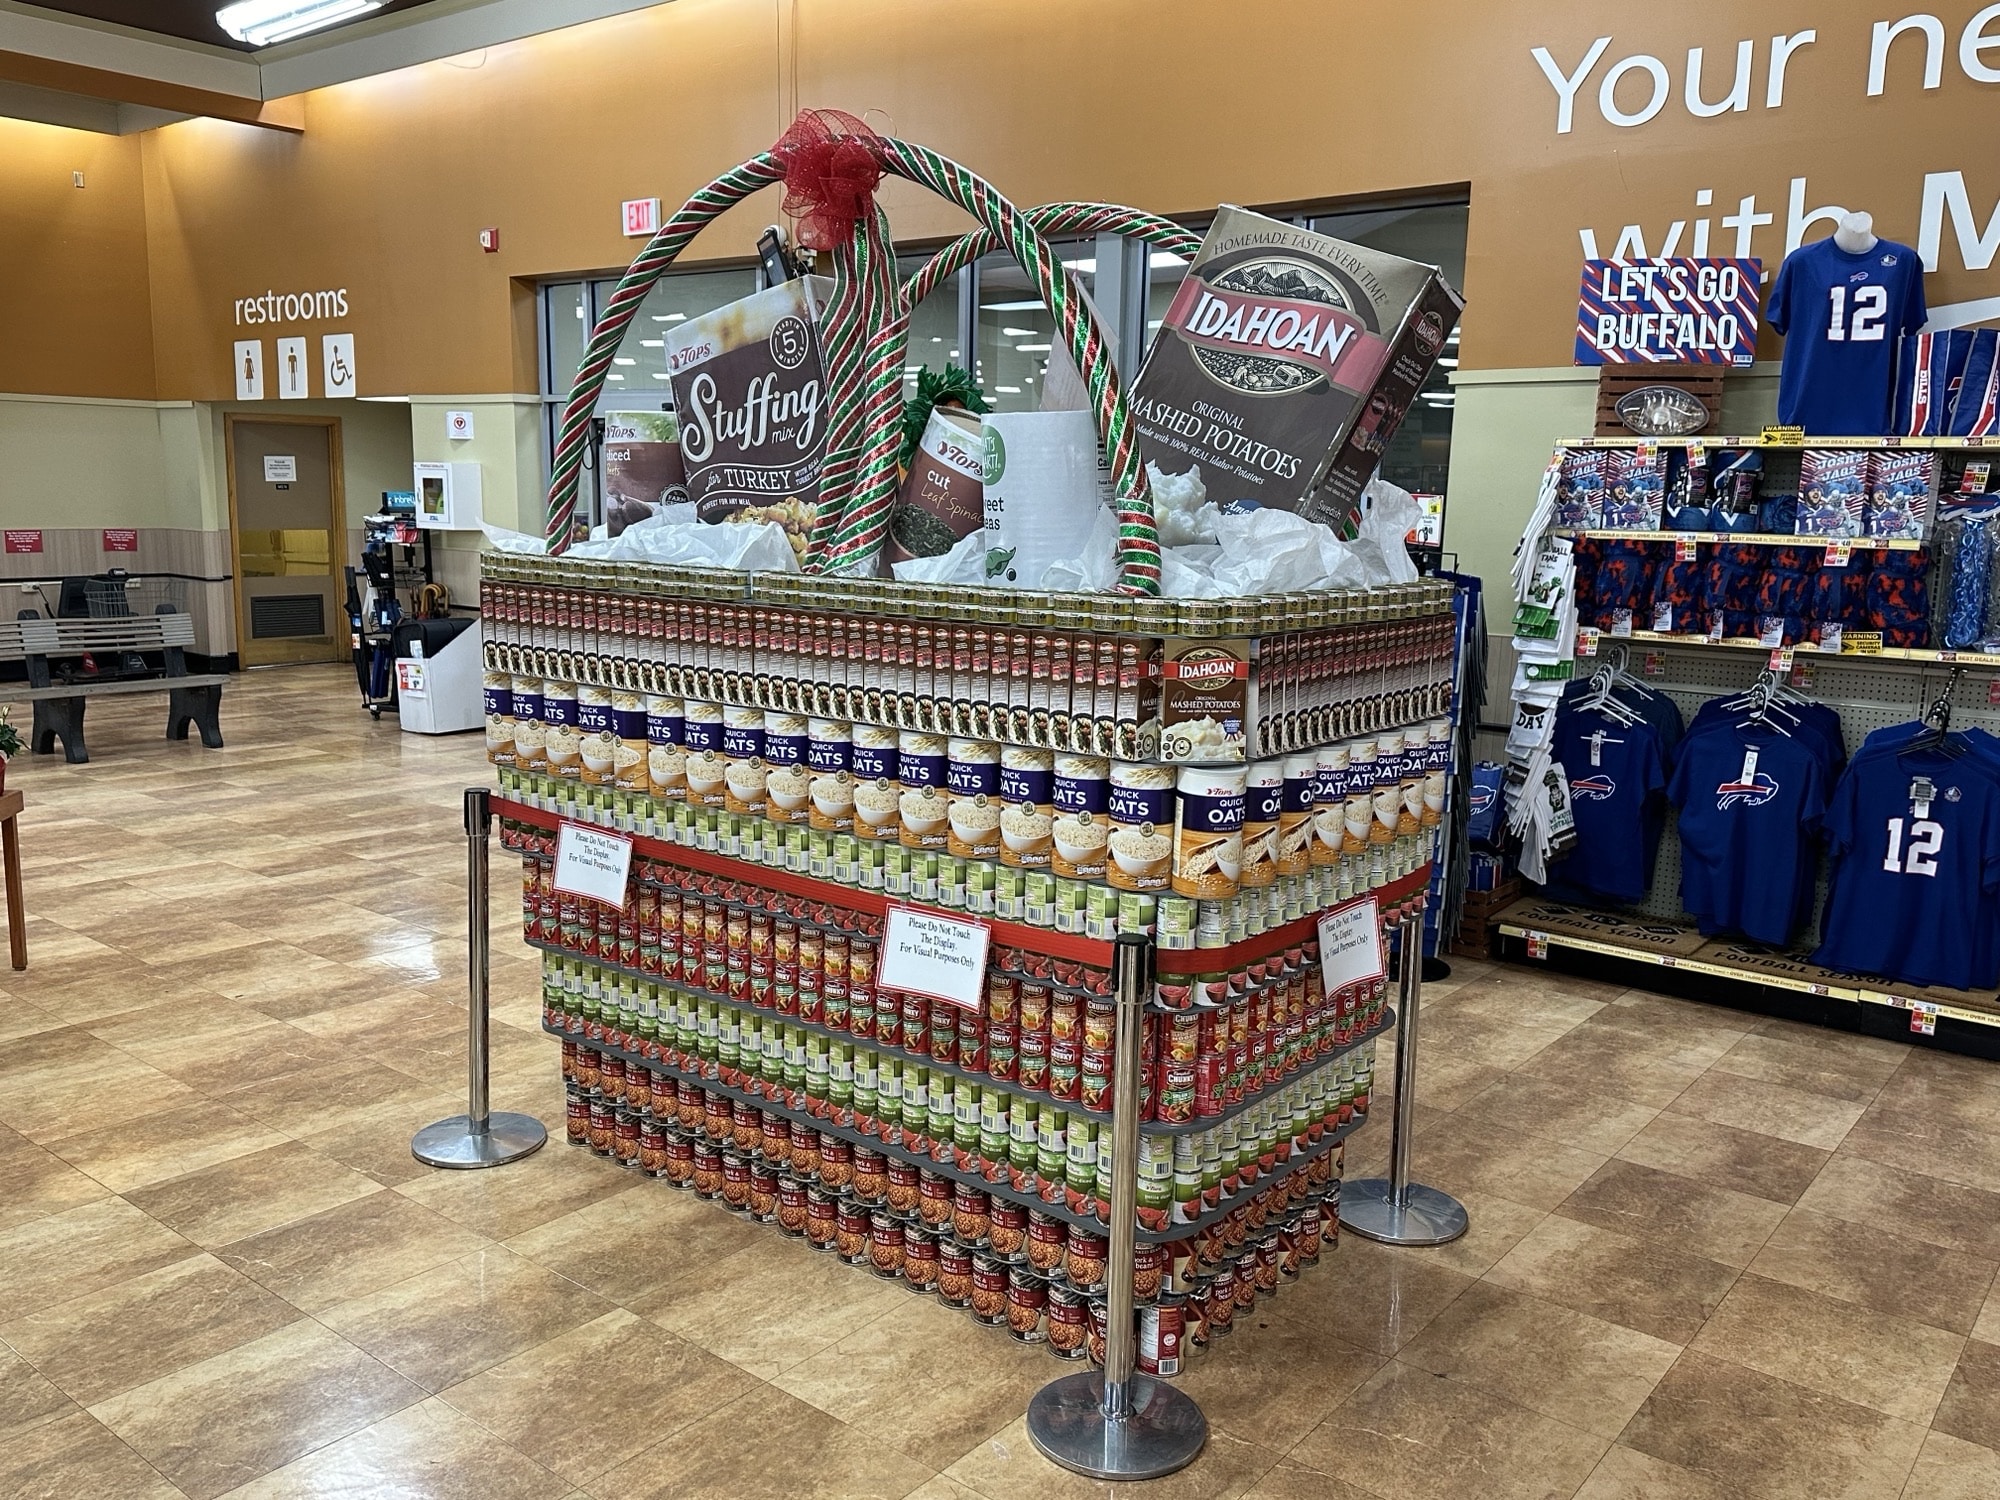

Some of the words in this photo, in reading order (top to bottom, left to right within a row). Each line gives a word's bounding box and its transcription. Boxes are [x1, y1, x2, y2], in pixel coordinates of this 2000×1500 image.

[1530, 30, 1816, 134] Your
[628, 202, 650, 231] EXIT
[1214, 232, 1289, 256] HOMEMADE
[1291, 233, 1327, 255] TASTE
[1327, 246, 1365, 276] EVERY
[1602, 266, 1688, 303] LET'S
[1697, 266, 1739, 302] GO
[234, 287, 348, 325] restrooms
[1828, 286, 1888, 341] 12
[1185, 291, 1355, 366] IDAHOAN
[1596, 313, 1738, 351] BUFFALO
[782, 330, 797, 354] 5
[1917, 369, 1929, 405] BILLS
[682, 372, 827, 463] Stuffing
[1192, 400, 1245, 431] ORIGINAL
[771, 426, 796, 445] mix
[1126, 392, 1203, 439] MASHED
[1201, 423, 1302, 480] POTATOES
[1135, 423, 1154, 437] Made
[1154, 430, 1170, 444] with
[1169, 438, 1189, 452] 100%
[1189, 446, 1209, 461] REAL
[1233, 465, 1265, 485] Potatoes
[1817, 454, 1863, 469] JOSH'S
[1882, 455, 1928, 469] JOSH'S
[705, 471, 721, 492] for
[724, 469, 791, 490] TURKEY
[927, 468, 951, 491] cut
[719, 498, 728, 506] FOR
[729, 498, 738, 506] ANY
[921, 482, 949, 510] Leaf
[946, 497, 985, 523] Spinac
[984, 497, 1004, 512] eet
[985, 518, 1000, 530] eas
[1179, 661, 1235, 679] IDAHOAN
[1170, 700, 1203, 709] MASHED
[1204, 700, 1241, 709] POTATOES
[1516, 713, 1545, 729] DAY
[726, 730, 747, 738] QUICK
[767, 736, 789, 745] QUICK
[724, 738, 756, 751] OATS
[765, 743, 798, 759] OATS
[811, 742, 834, 751] QUICK
[808, 751, 843, 765] OATS
[1402, 757, 1426, 771] OAT
[950, 763, 973, 773] QUICK
[1319, 772, 1345, 781] QUICK
[947, 772, 982, 788] OATS
[1055, 777, 1077, 789] QUICK
[1314, 779, 1348, 795] OATS
[1113, 788, 1139, 800] QUICK
[1109, 797, 1149, 816] OATS
[575, 832, 588, 841] Please
[590, 835, 597, 844] Do
[606, 840, 619, 851] Touch
[1883, 818, 1944, 877] 12
[569, 853, 578, 862] For
[908, 917, 927, 929] Please
[928, 921, 938, 932] Do
[939, 923, 951, 935] Not
[952, 927, 971, 940] Touch
[1517, 911, 1600, 932] FOOTBALL
[920, 933, 932, 945] The
[933, 935, 957, 952] Display.
[1356, 933, 1369, 945] Only
[900, 942, 912, 953] For
[913, 945, 932, 958] Visual
[933, 949, 960, 965] Purposes
[961, 956, 975, 971] Only
[1714, 951, 1809, 974] FOOTBALL
[1168, 1074, 1194, 1083] CHUNKY
